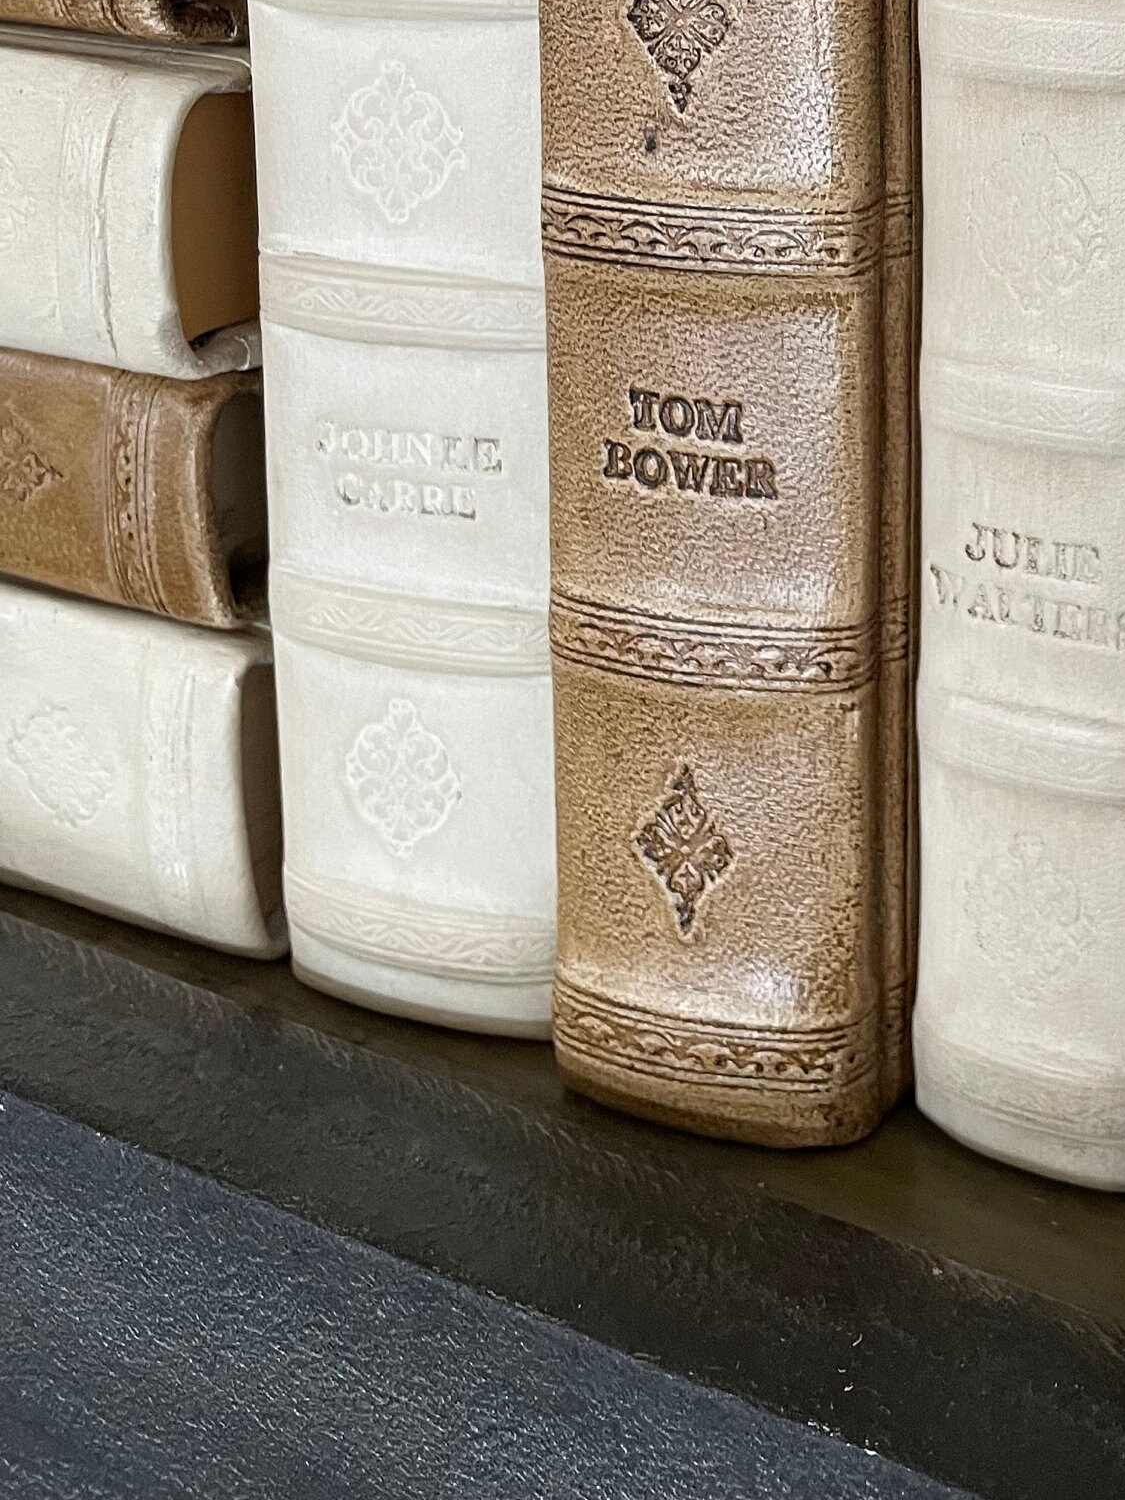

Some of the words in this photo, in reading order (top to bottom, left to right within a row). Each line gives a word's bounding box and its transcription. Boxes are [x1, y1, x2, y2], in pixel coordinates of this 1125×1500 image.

[313, 418, 436, 470] JOHN
[627, 381, 744, 445] TOM
[602, 437, 780, 501] BOWER
